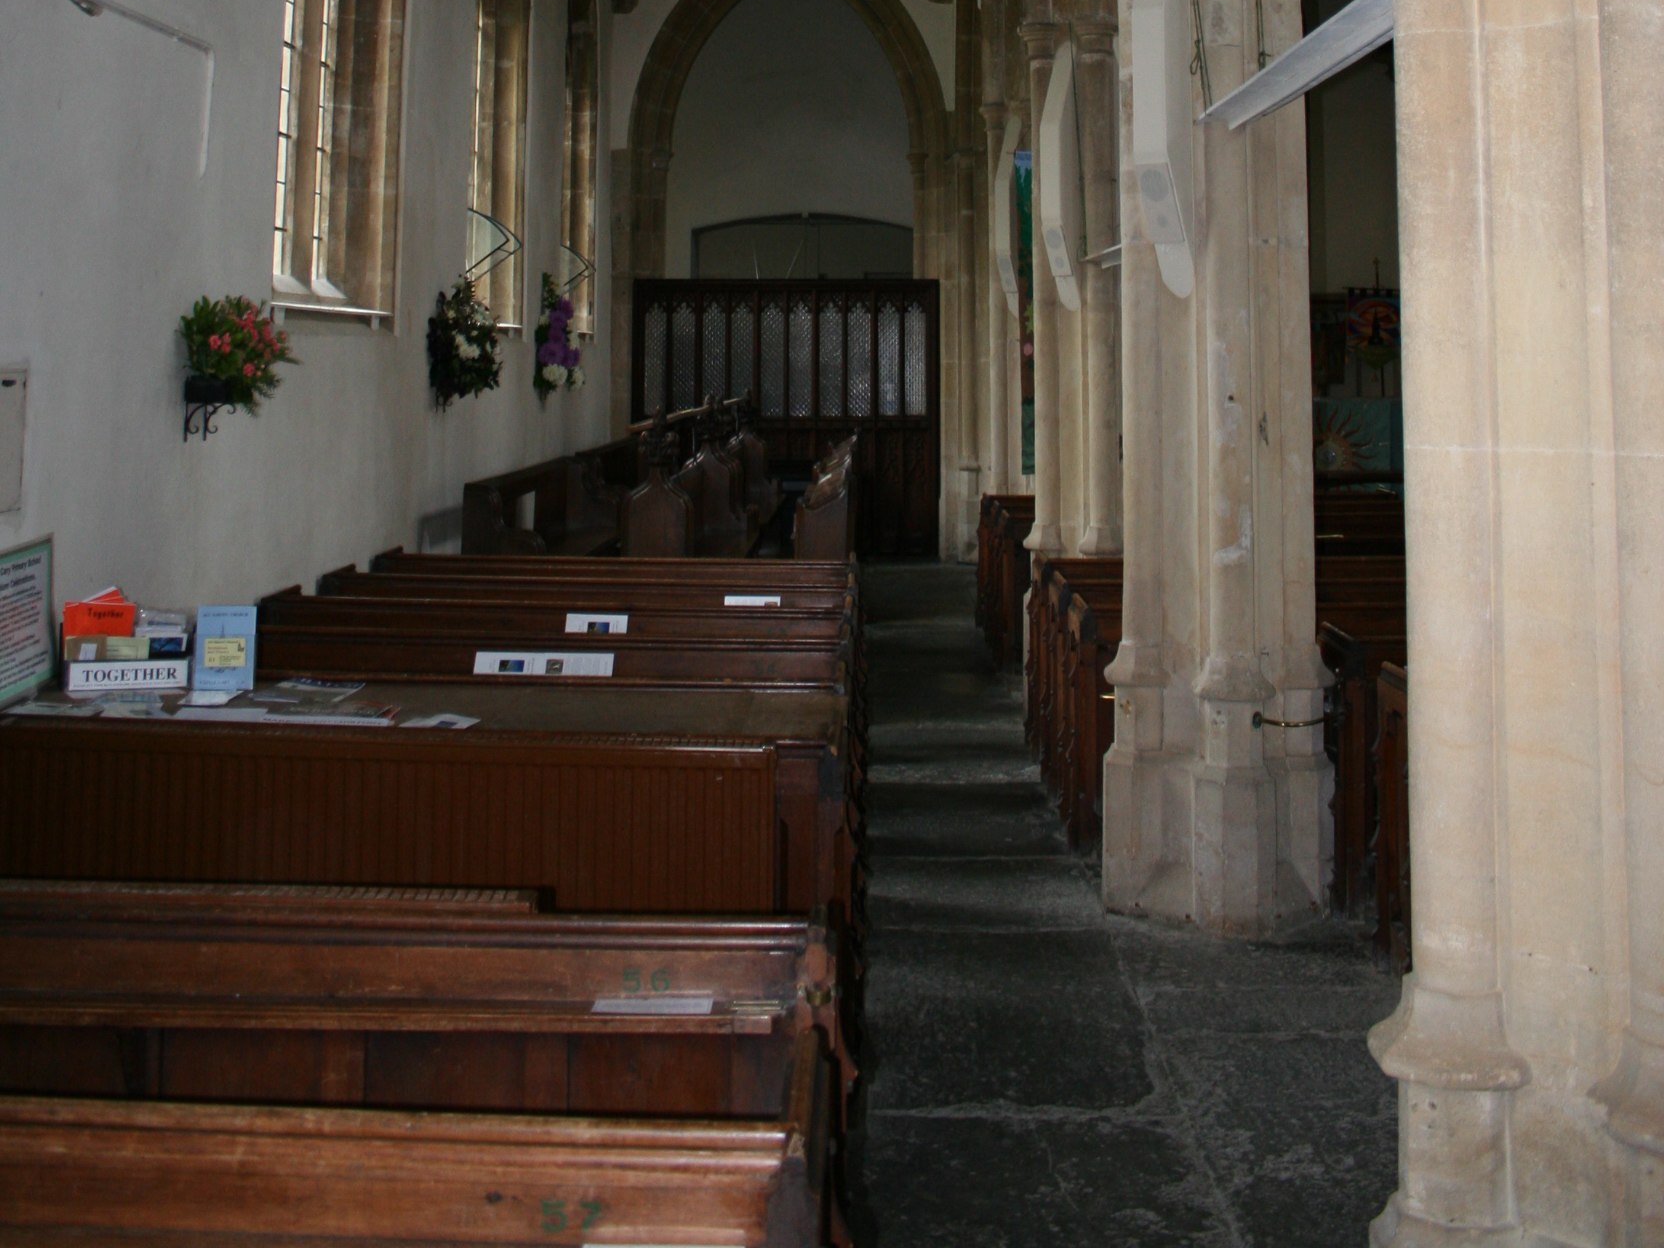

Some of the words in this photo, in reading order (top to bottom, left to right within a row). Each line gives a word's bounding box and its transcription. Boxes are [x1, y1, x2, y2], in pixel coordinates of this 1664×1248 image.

[87, 607, 125, 620] Together
[82, 667, 177, 683] TOGETHER
[622, 967, 671, 993] 56
[542, 1199, 602, 1233] 57
